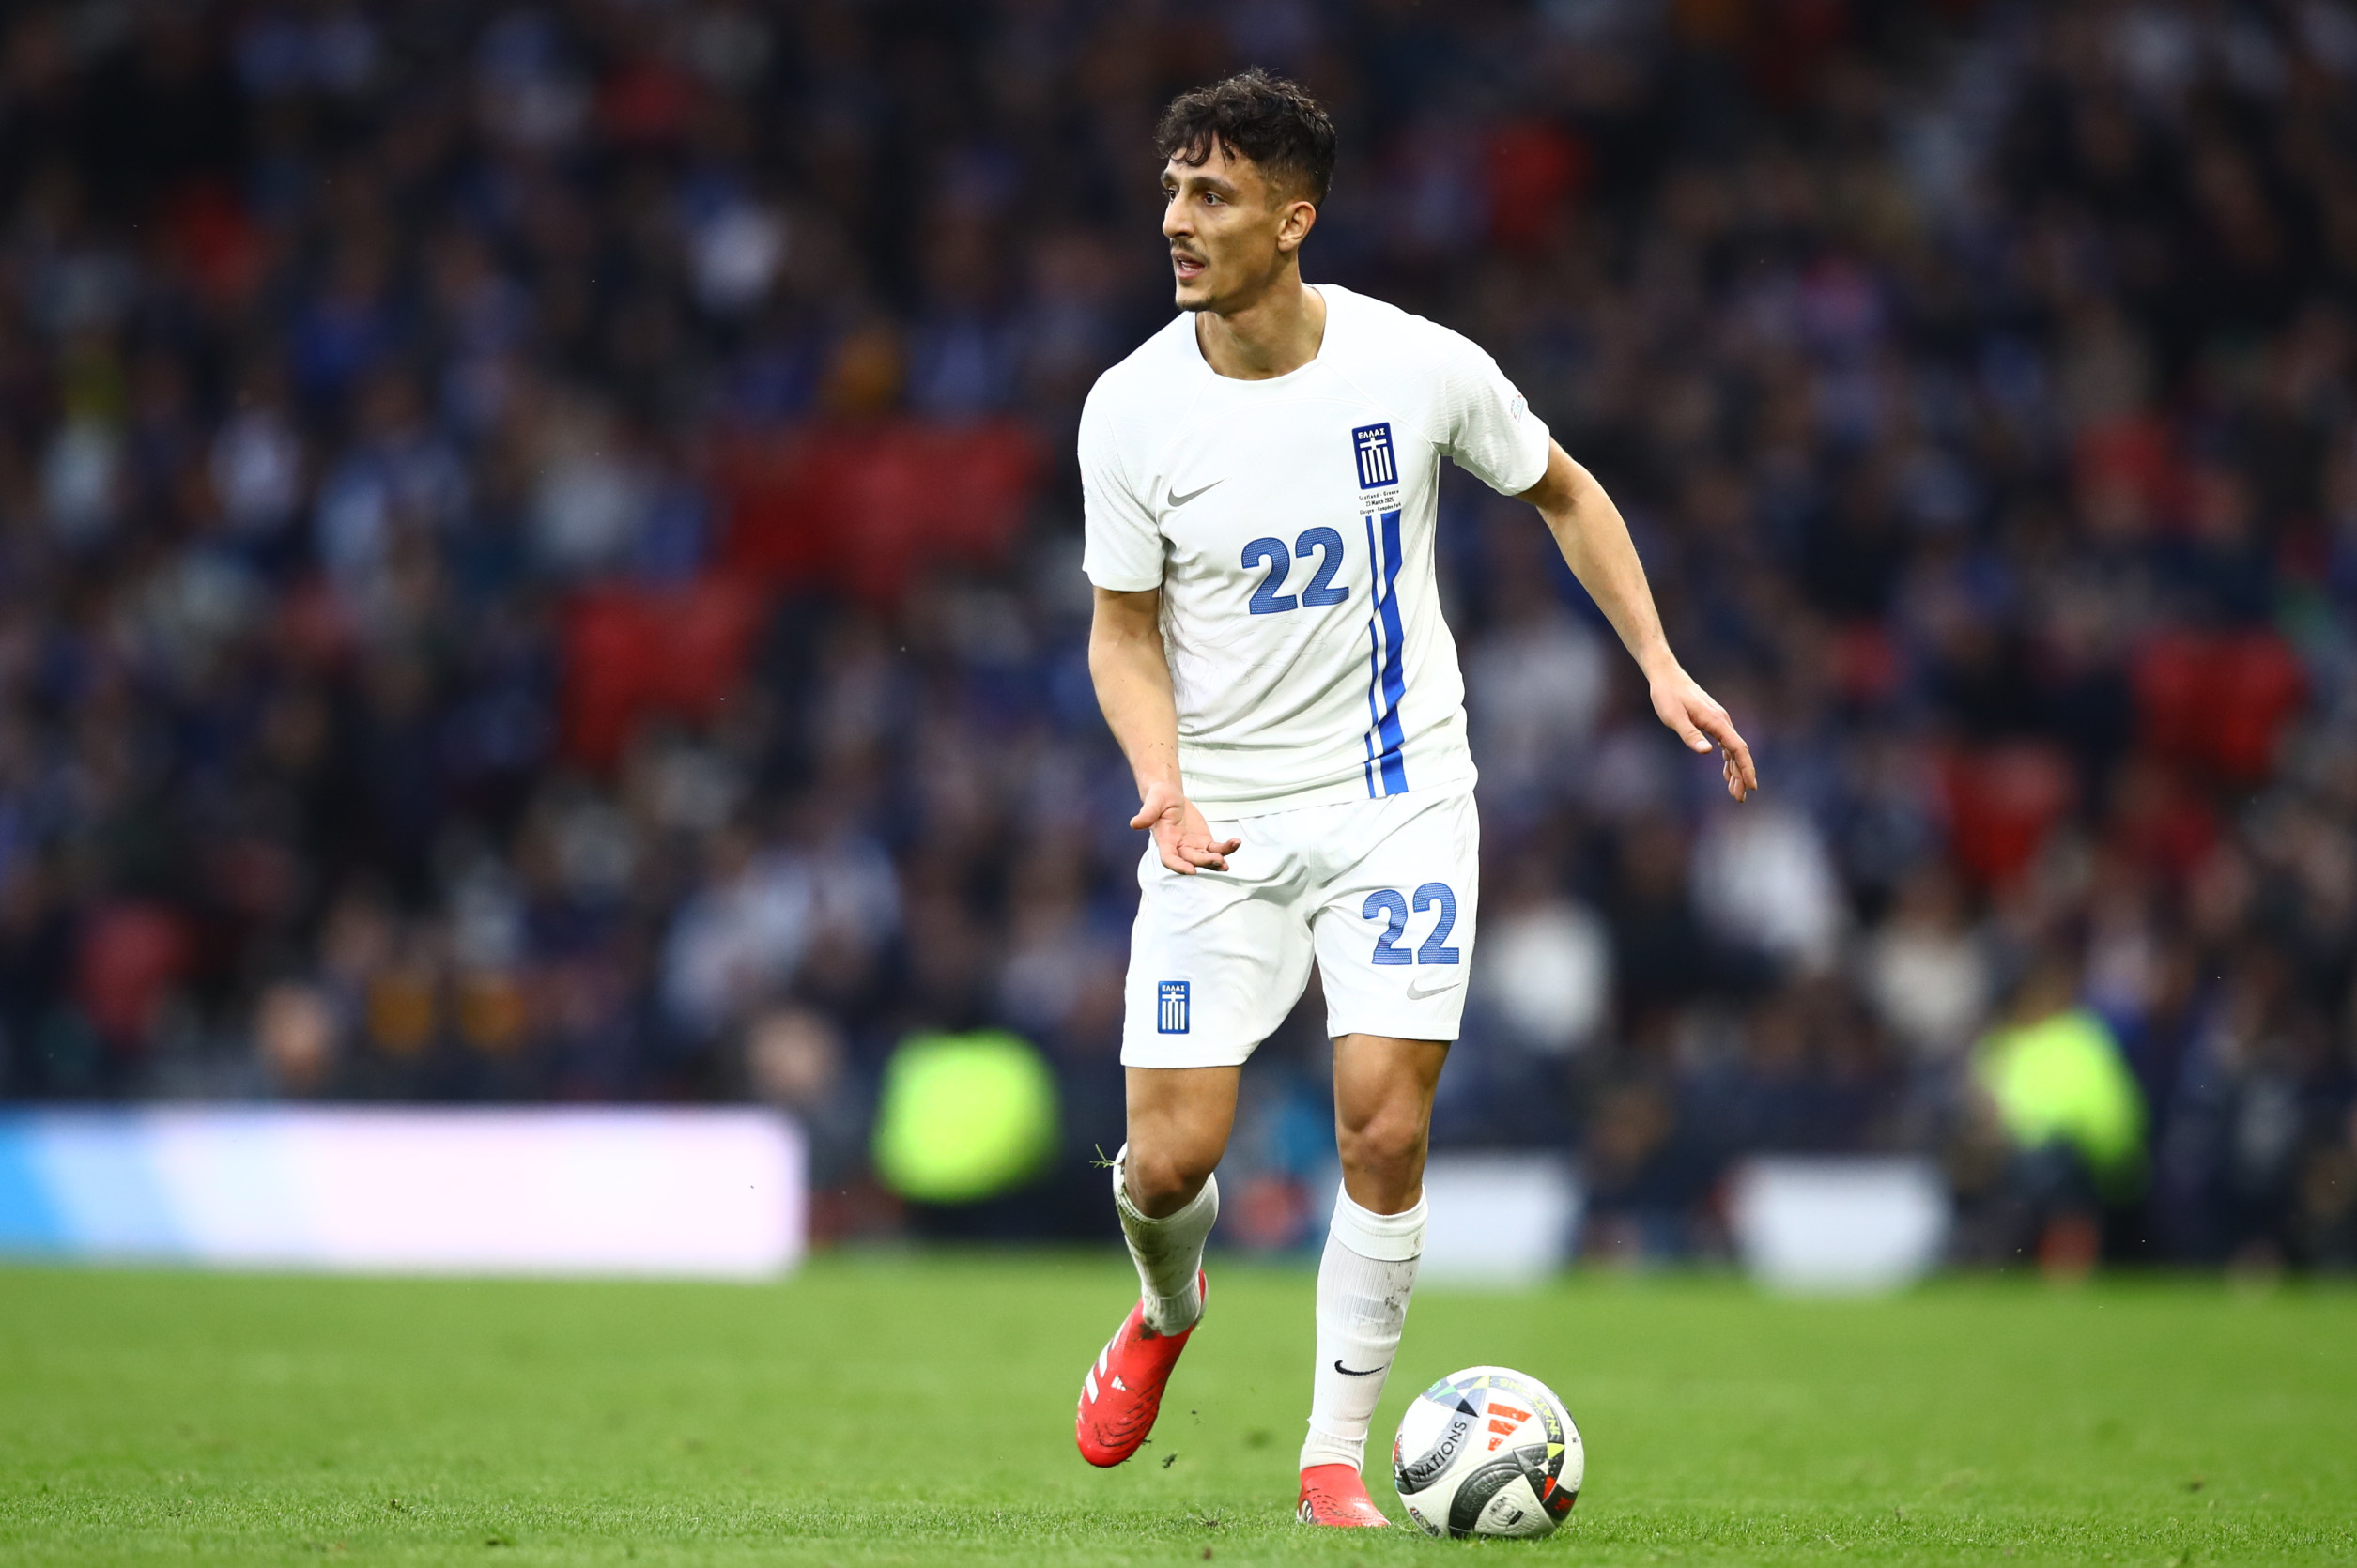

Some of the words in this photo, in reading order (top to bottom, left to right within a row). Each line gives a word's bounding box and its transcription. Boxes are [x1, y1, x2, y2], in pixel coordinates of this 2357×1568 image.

[1358, 428, 1385, 439] ΕΛΛΑΣ
[1241, 527, 1349, 615] 22
[1363, 882, 1459, 965] 22
[1415, 1421, 1467, 1481] NATIONS
